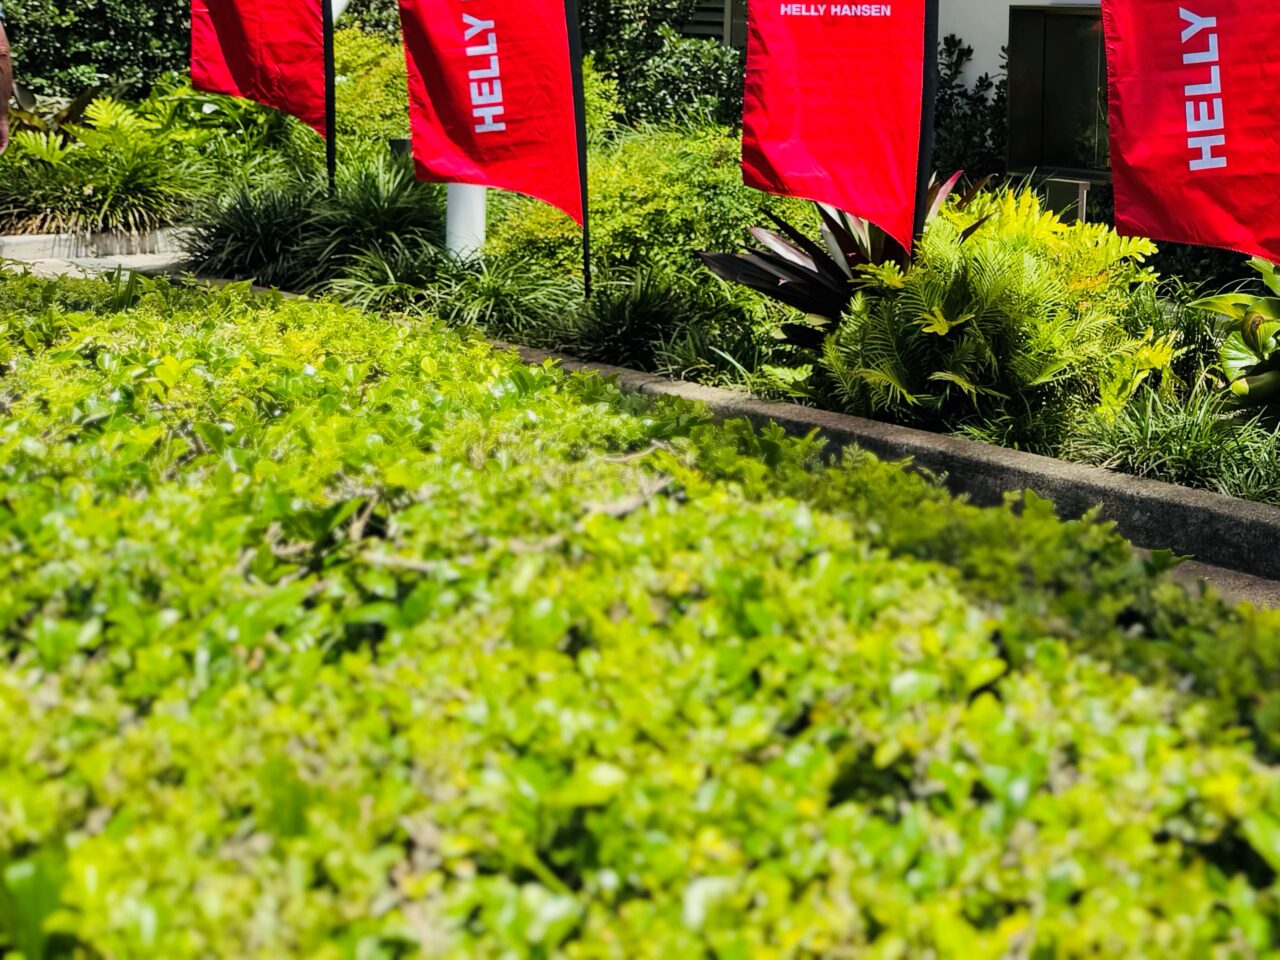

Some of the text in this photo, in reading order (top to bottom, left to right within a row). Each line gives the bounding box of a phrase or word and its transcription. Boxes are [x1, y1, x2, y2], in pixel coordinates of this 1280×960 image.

[780, 3, 891, 17] HELLY HANSEN
[463, 14, 506, 133] HELLY
[1179, 6, 1227, 171] HELLY
